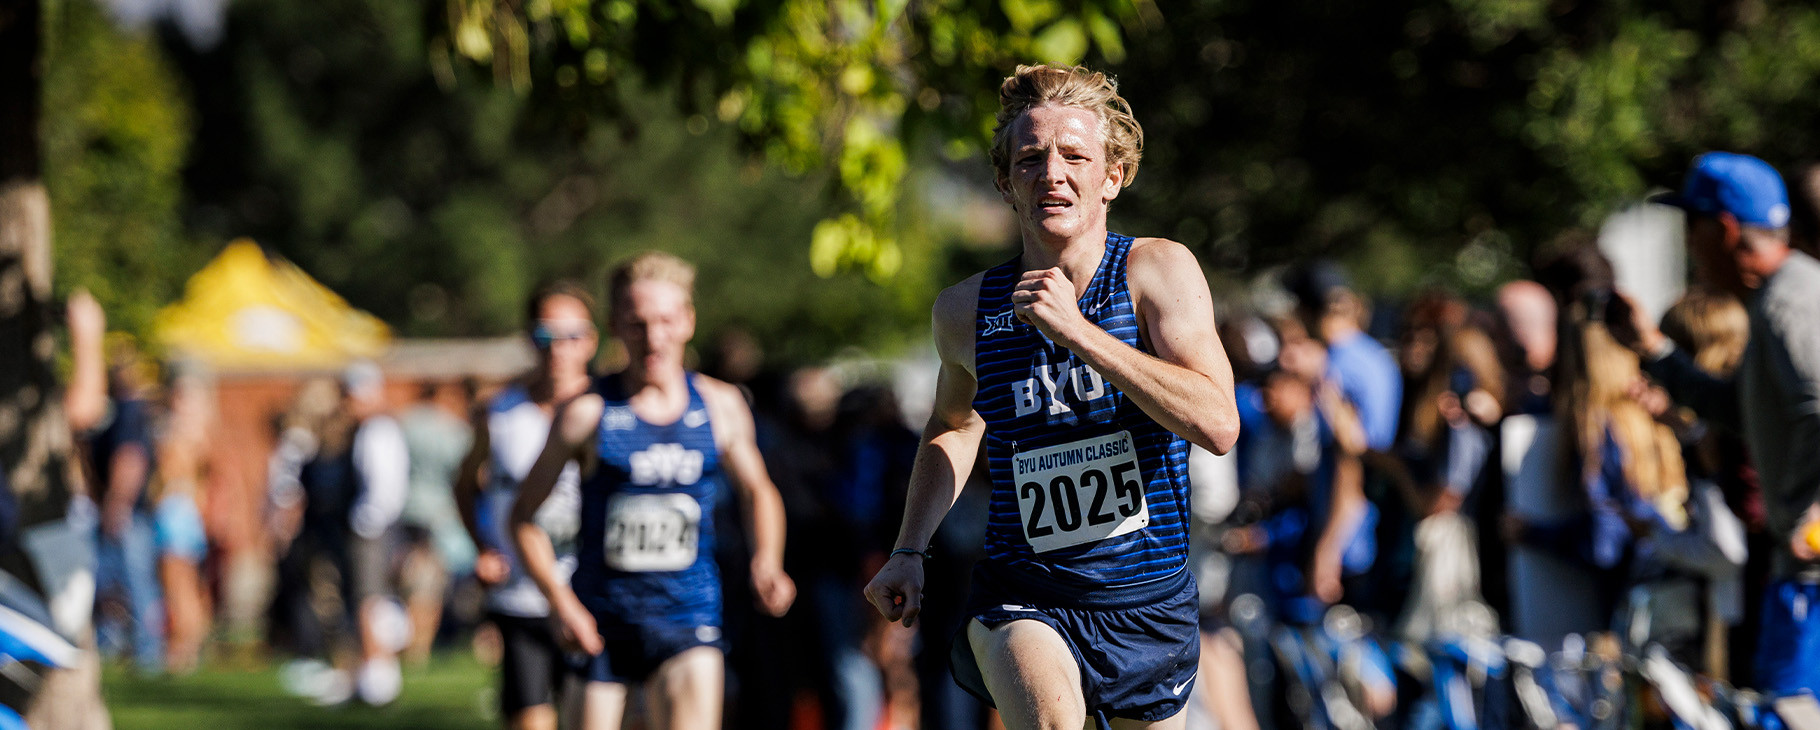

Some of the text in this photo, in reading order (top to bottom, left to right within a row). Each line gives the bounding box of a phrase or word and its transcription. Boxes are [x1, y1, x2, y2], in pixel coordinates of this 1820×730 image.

[1011, 360, 1105, 418] BYU
[1019, 438, 1129, 475] BYU AUTUMN CLASSIC
[1020, 460, 1143, 540] 2025
